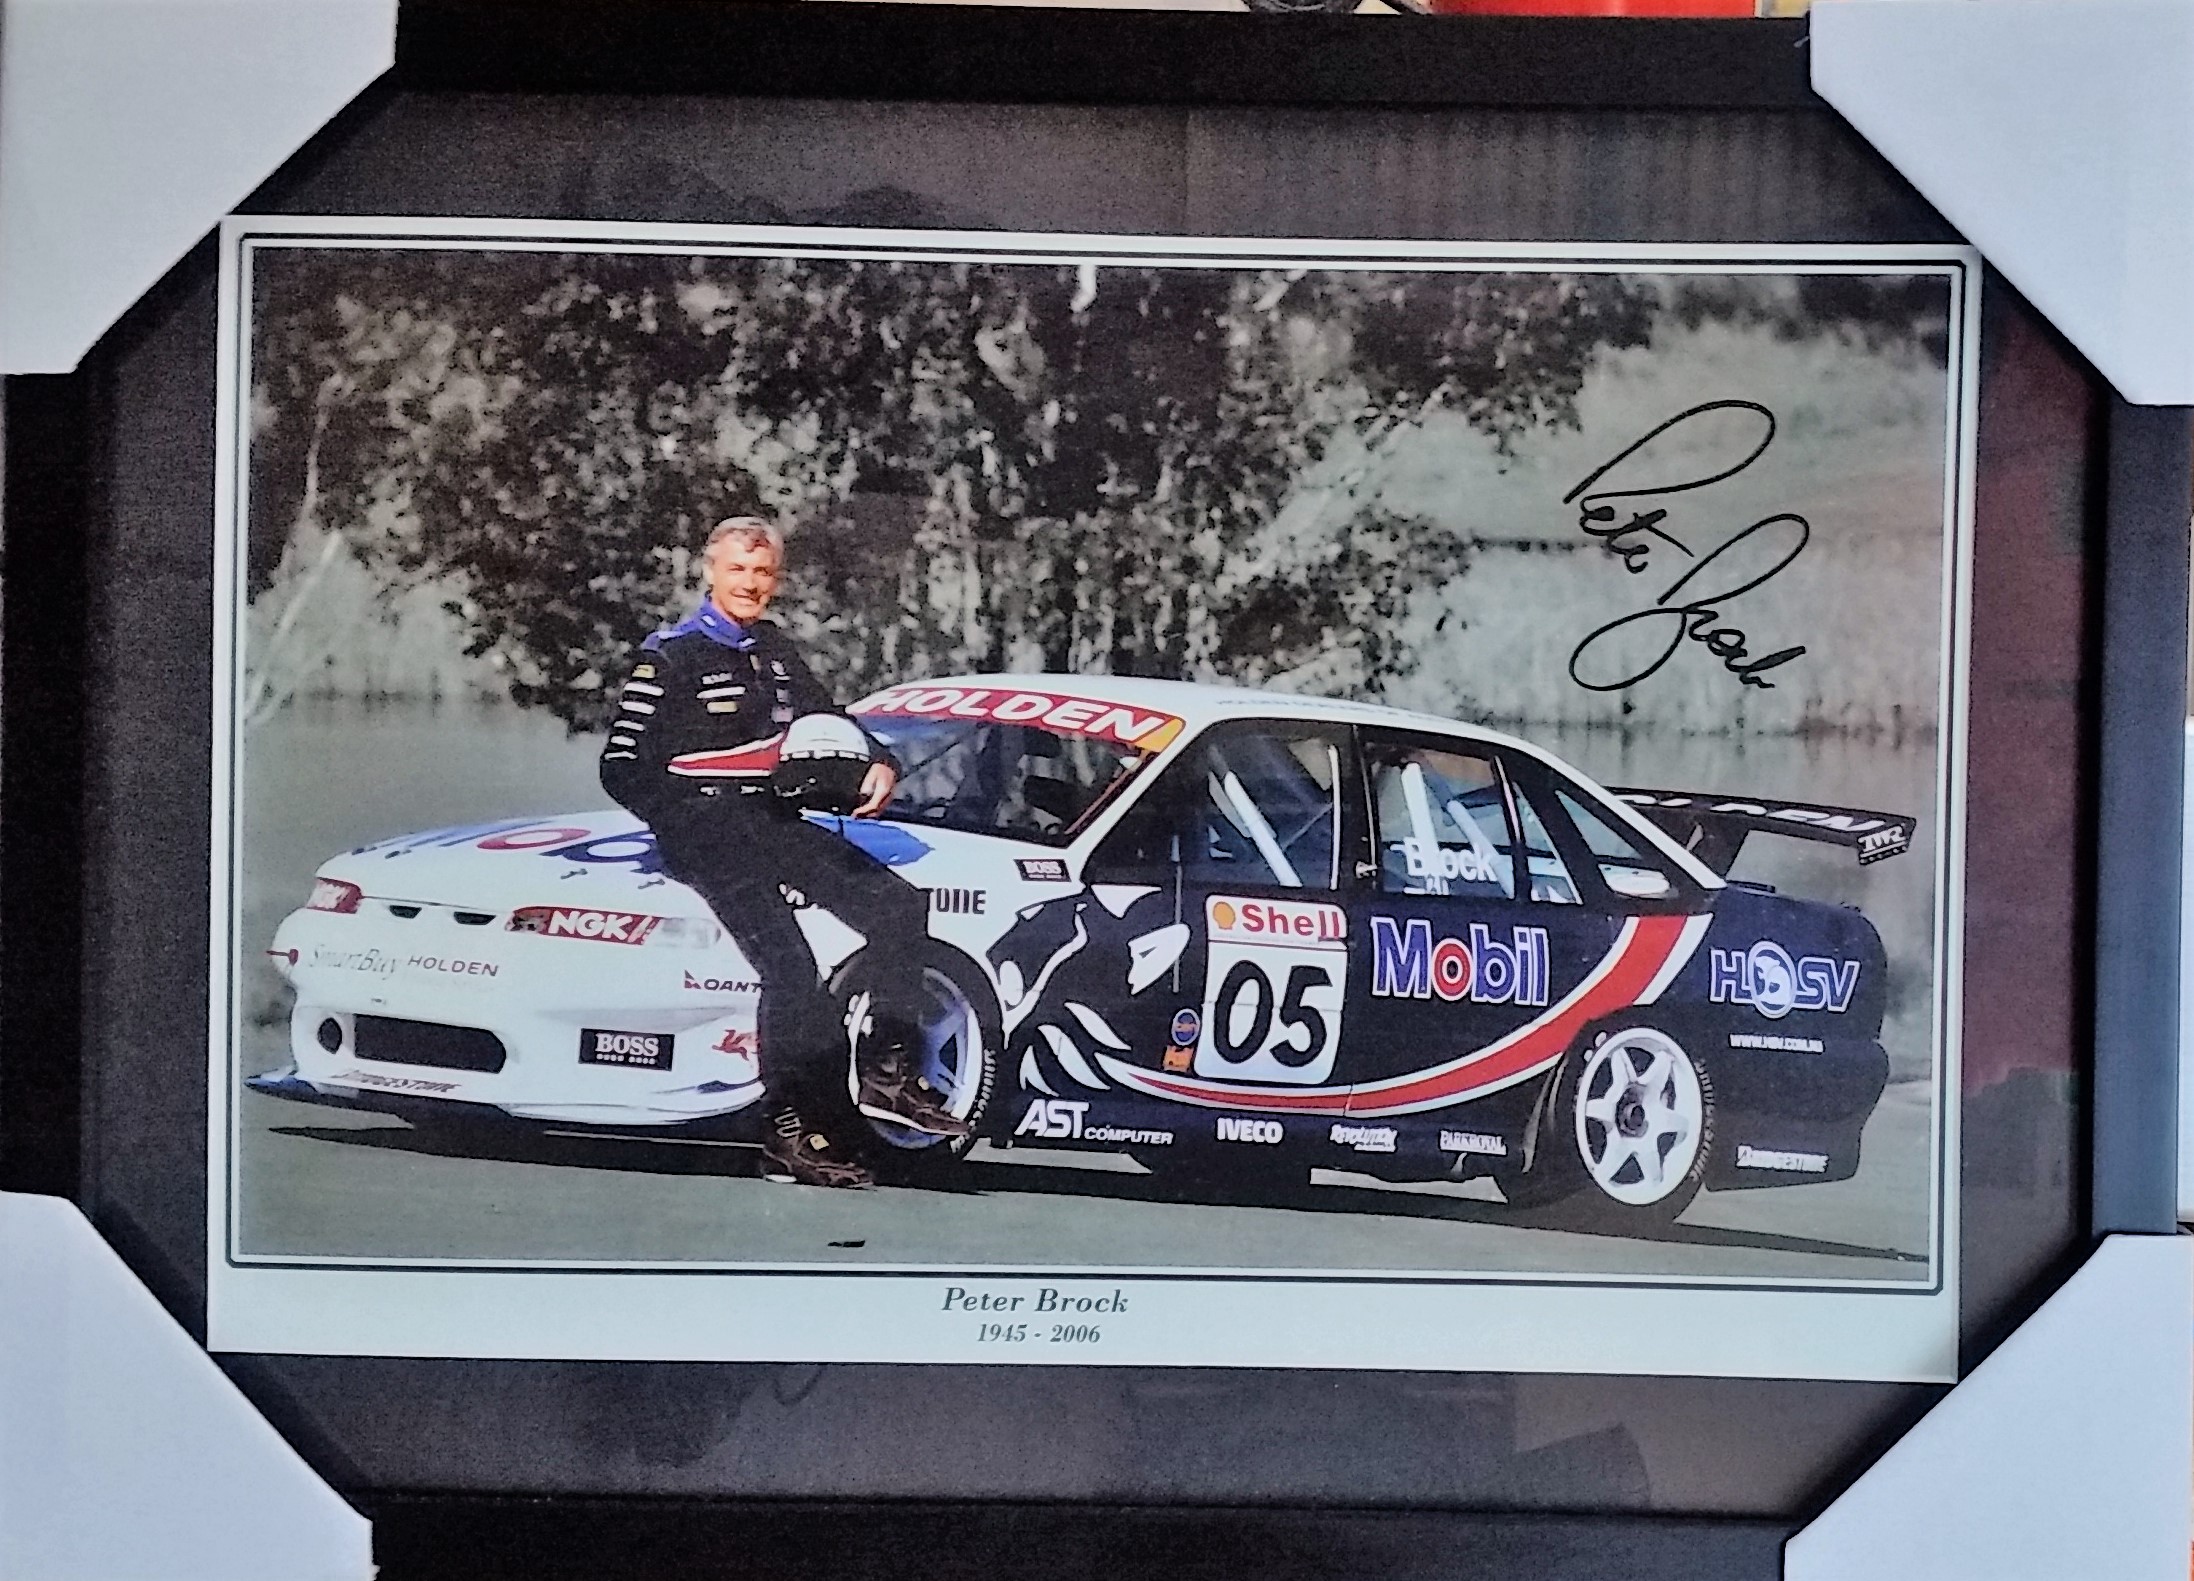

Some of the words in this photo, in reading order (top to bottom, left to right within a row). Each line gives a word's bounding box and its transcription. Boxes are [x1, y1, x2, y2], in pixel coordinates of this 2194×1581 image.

[858, 688, 1153, 742] HOLDEN
[548, 910, 633, 941] NGK
[1240, 903, 1341, 939] Shell
[407, 954, 499, 977] HOLDEN
[1370, 916, 1550, 1007] Mobil
[1213, 959, 1334, 1068] 05
[595, 1033, 660, 1058] BOSS
[1014, 1098, 1090, 1139] AST
[1083, 1125, 1175, 1146] COMPUTER
[1216, 1116, 1284, 1144] IVECO
[941, 1287, 1025, 1312] Peter
[1034, 1288, 1129, 1313] Brock
[977, 1323, 1028, 1343] 1945
[1050, 1324, 1101, 1344] 2006
